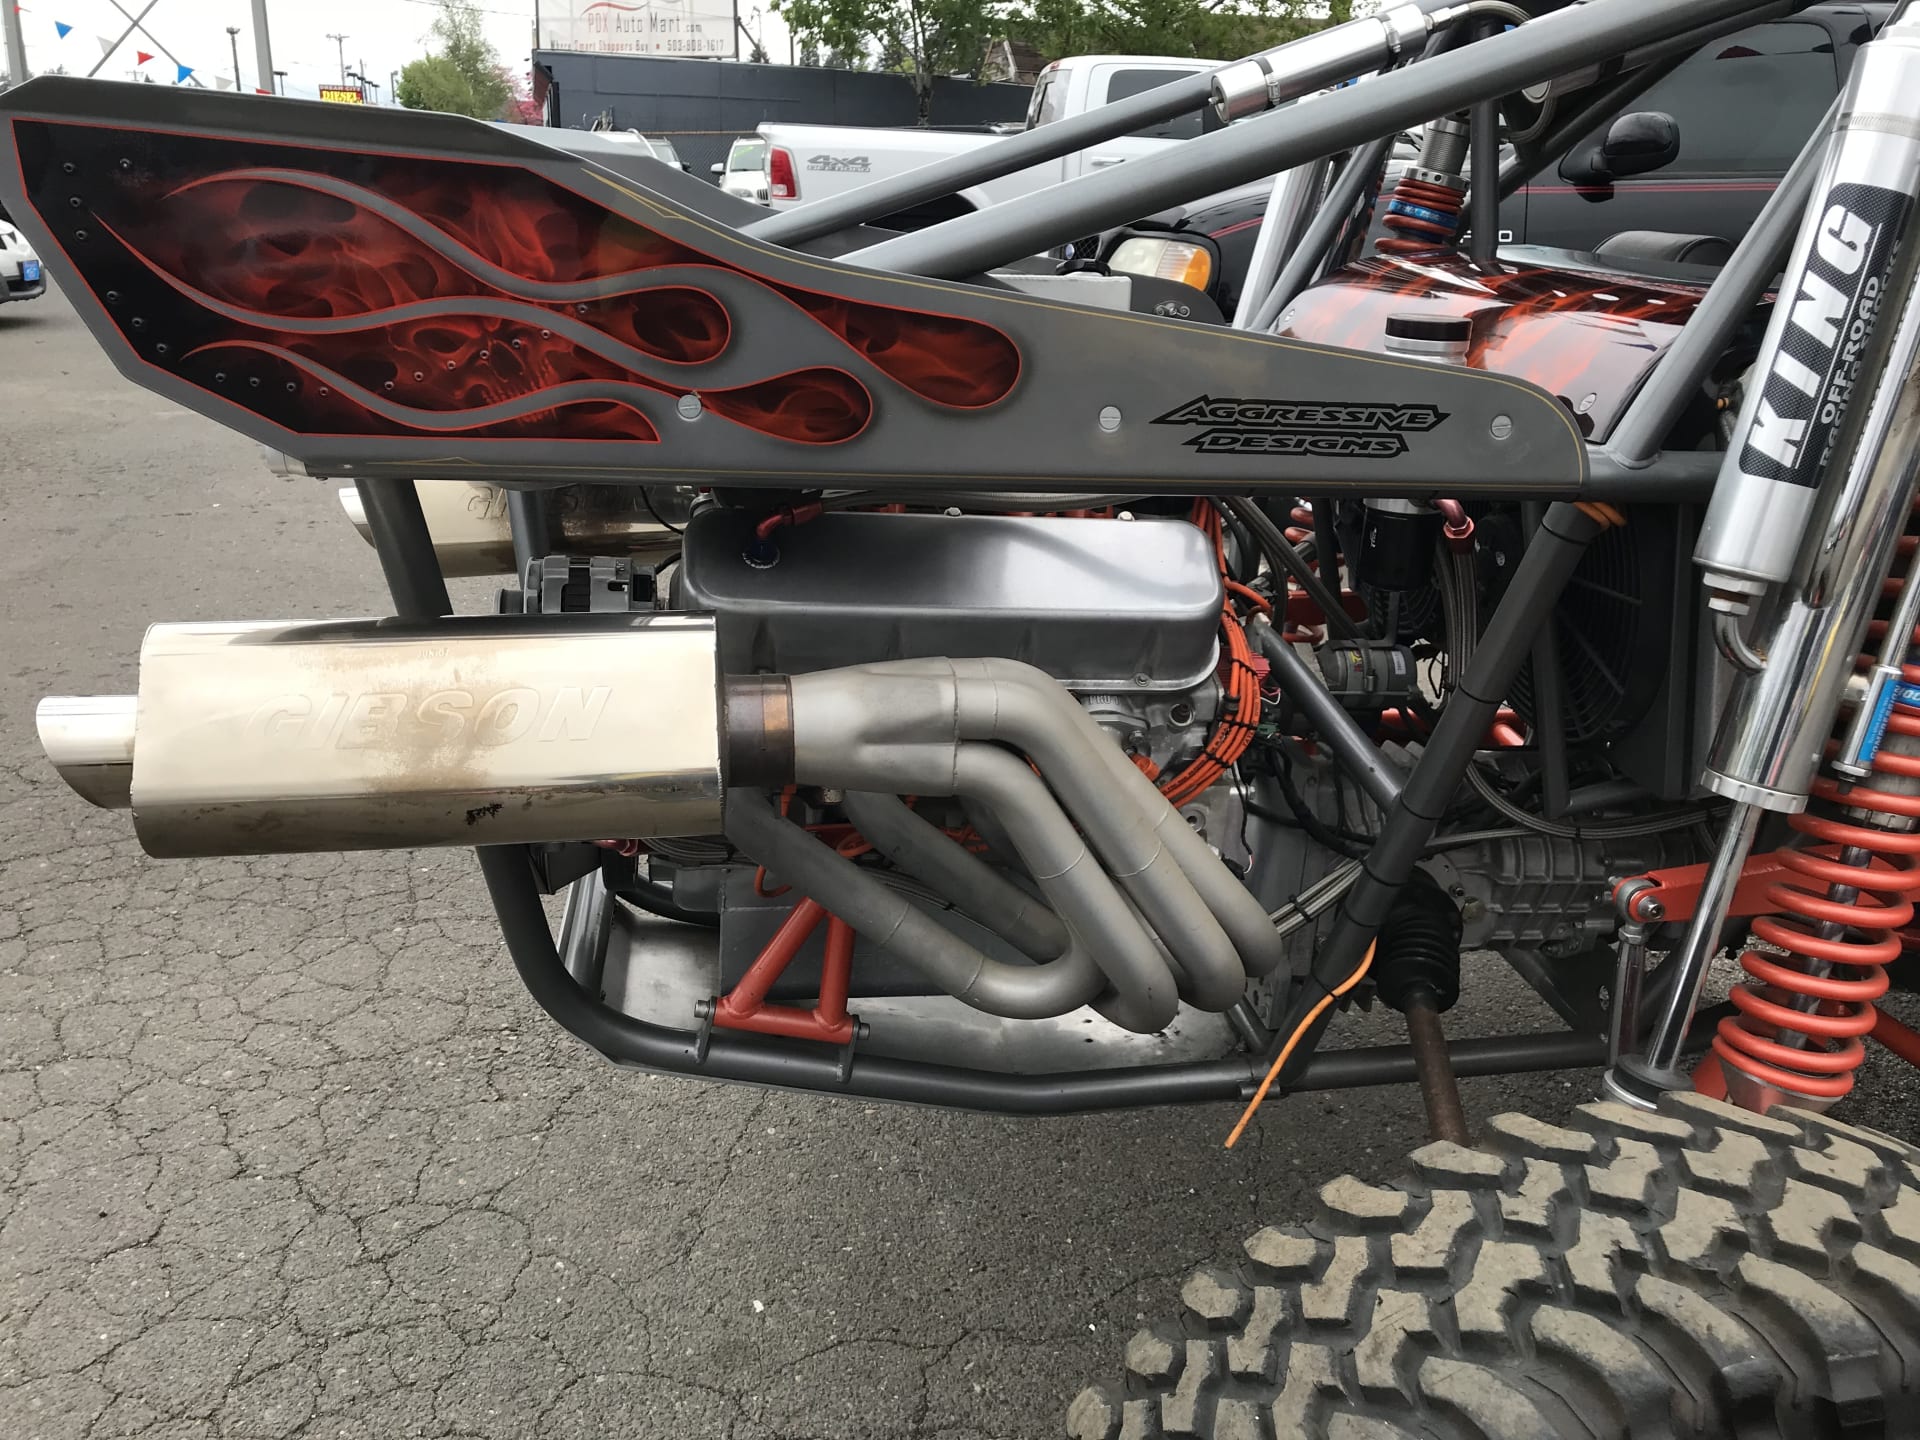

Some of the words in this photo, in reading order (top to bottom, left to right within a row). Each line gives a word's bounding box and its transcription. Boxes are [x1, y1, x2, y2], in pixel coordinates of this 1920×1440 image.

[588, 12, 608, 32] PDX
[616, 13, 643, 33] Auto
[650, 13, 681, 33] Mart
[1748, 203, 1873, 469] KING
[1820, 276, 1879, 425] OFF-ROAD
[1165, 398, 1440, 428] AGGRESSIVE
[1198, 433, 1402, 454] DESIGNS
[246, 686, 613, 750] GIBSON
